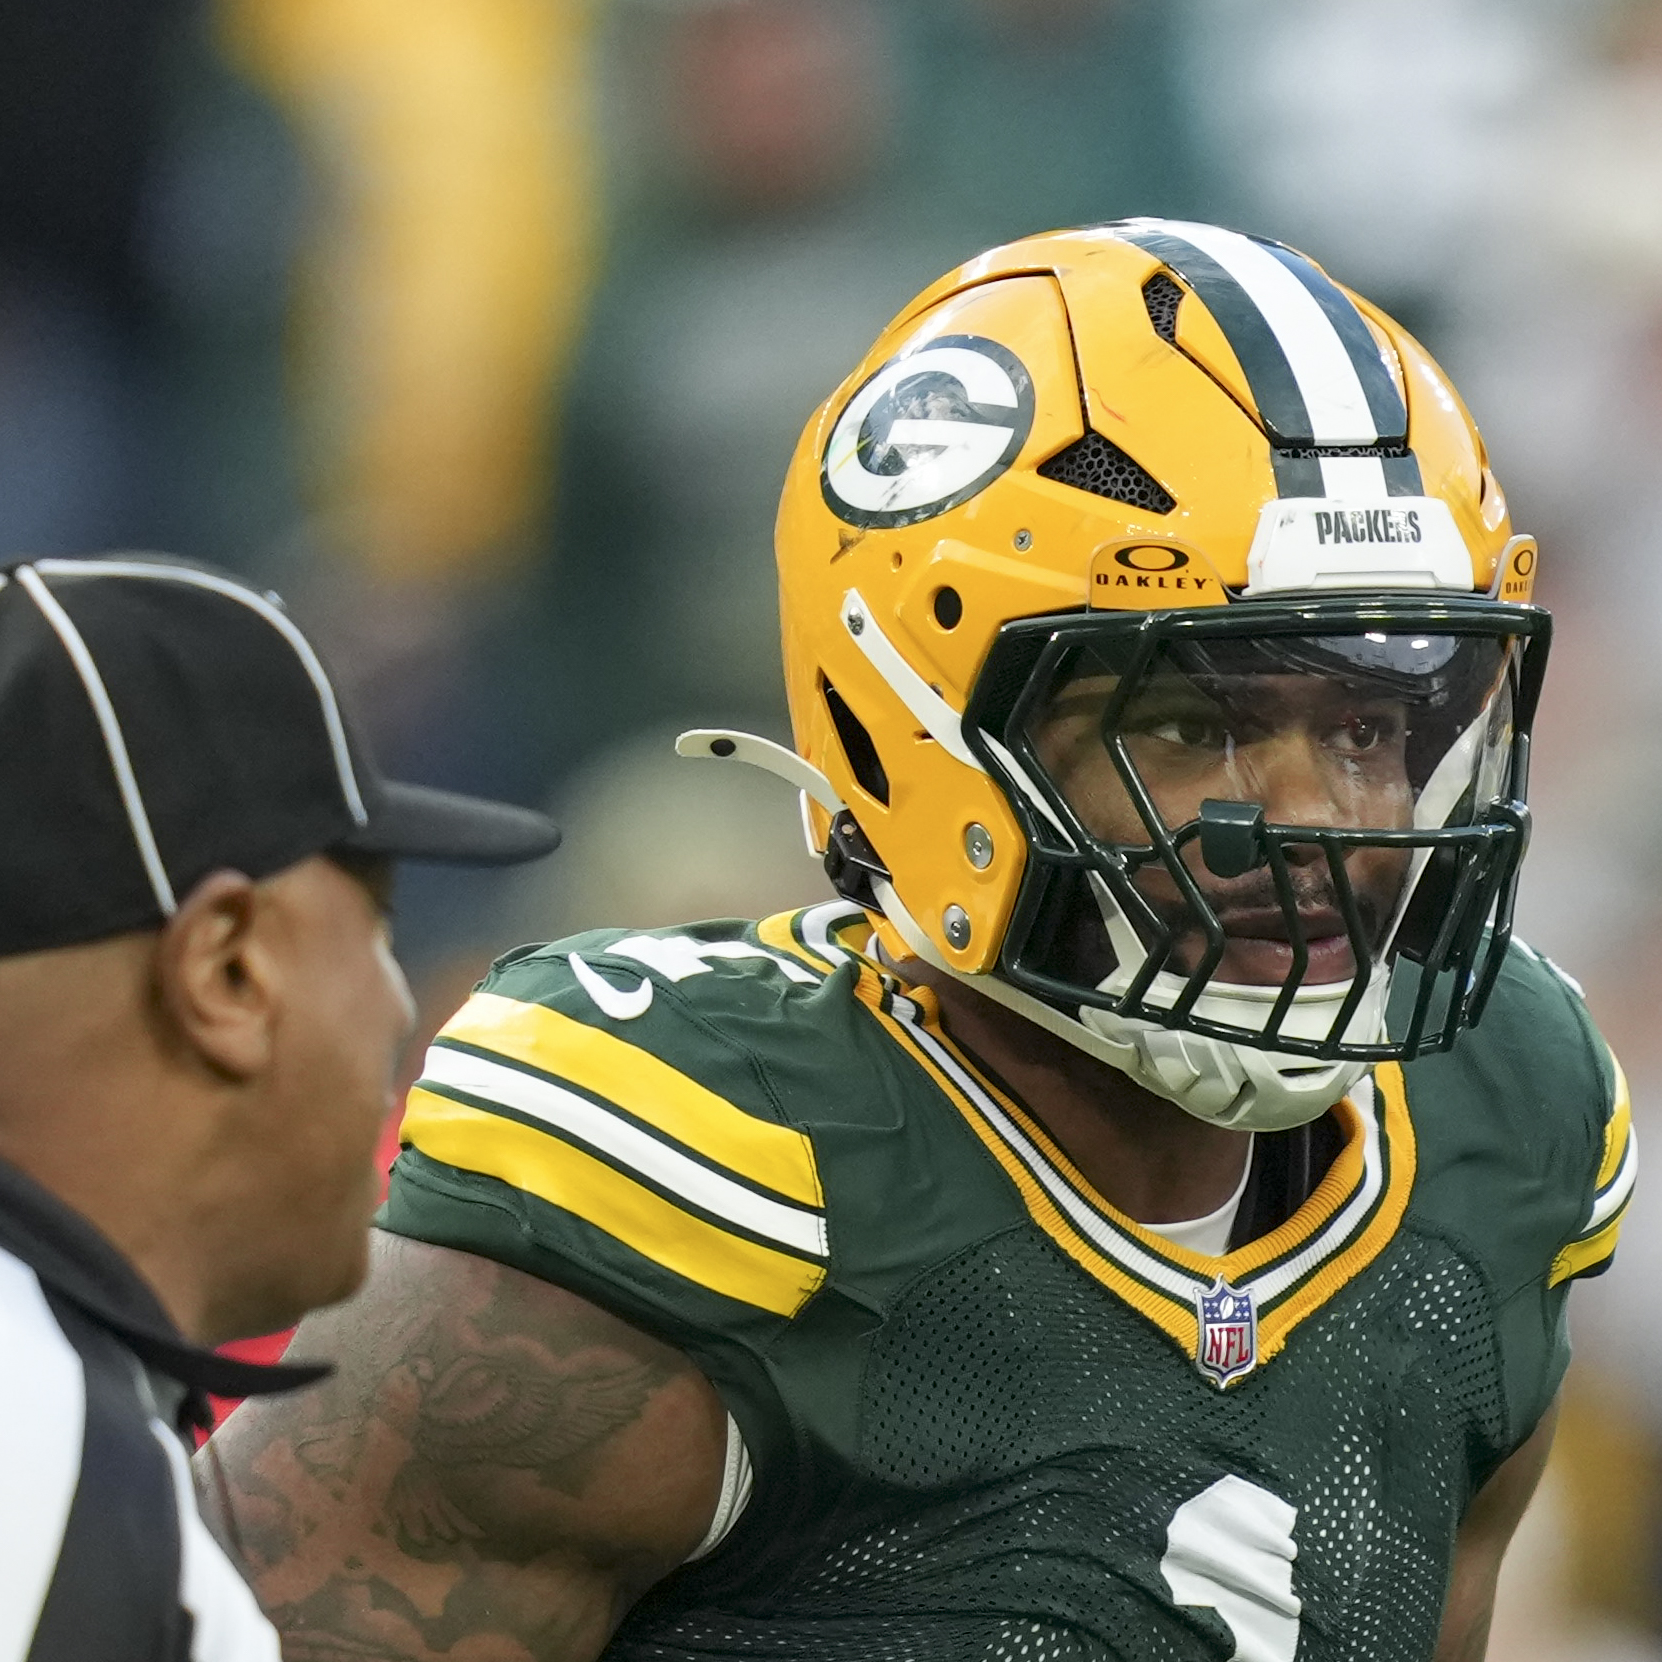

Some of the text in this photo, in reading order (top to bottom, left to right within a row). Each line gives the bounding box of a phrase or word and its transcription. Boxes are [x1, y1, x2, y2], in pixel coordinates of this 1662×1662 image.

[827, 347, 1019, 512] G
[1096, 573, 1208, 590] OAKLEY
[1207, 1326, 1249, 1369] NFL
